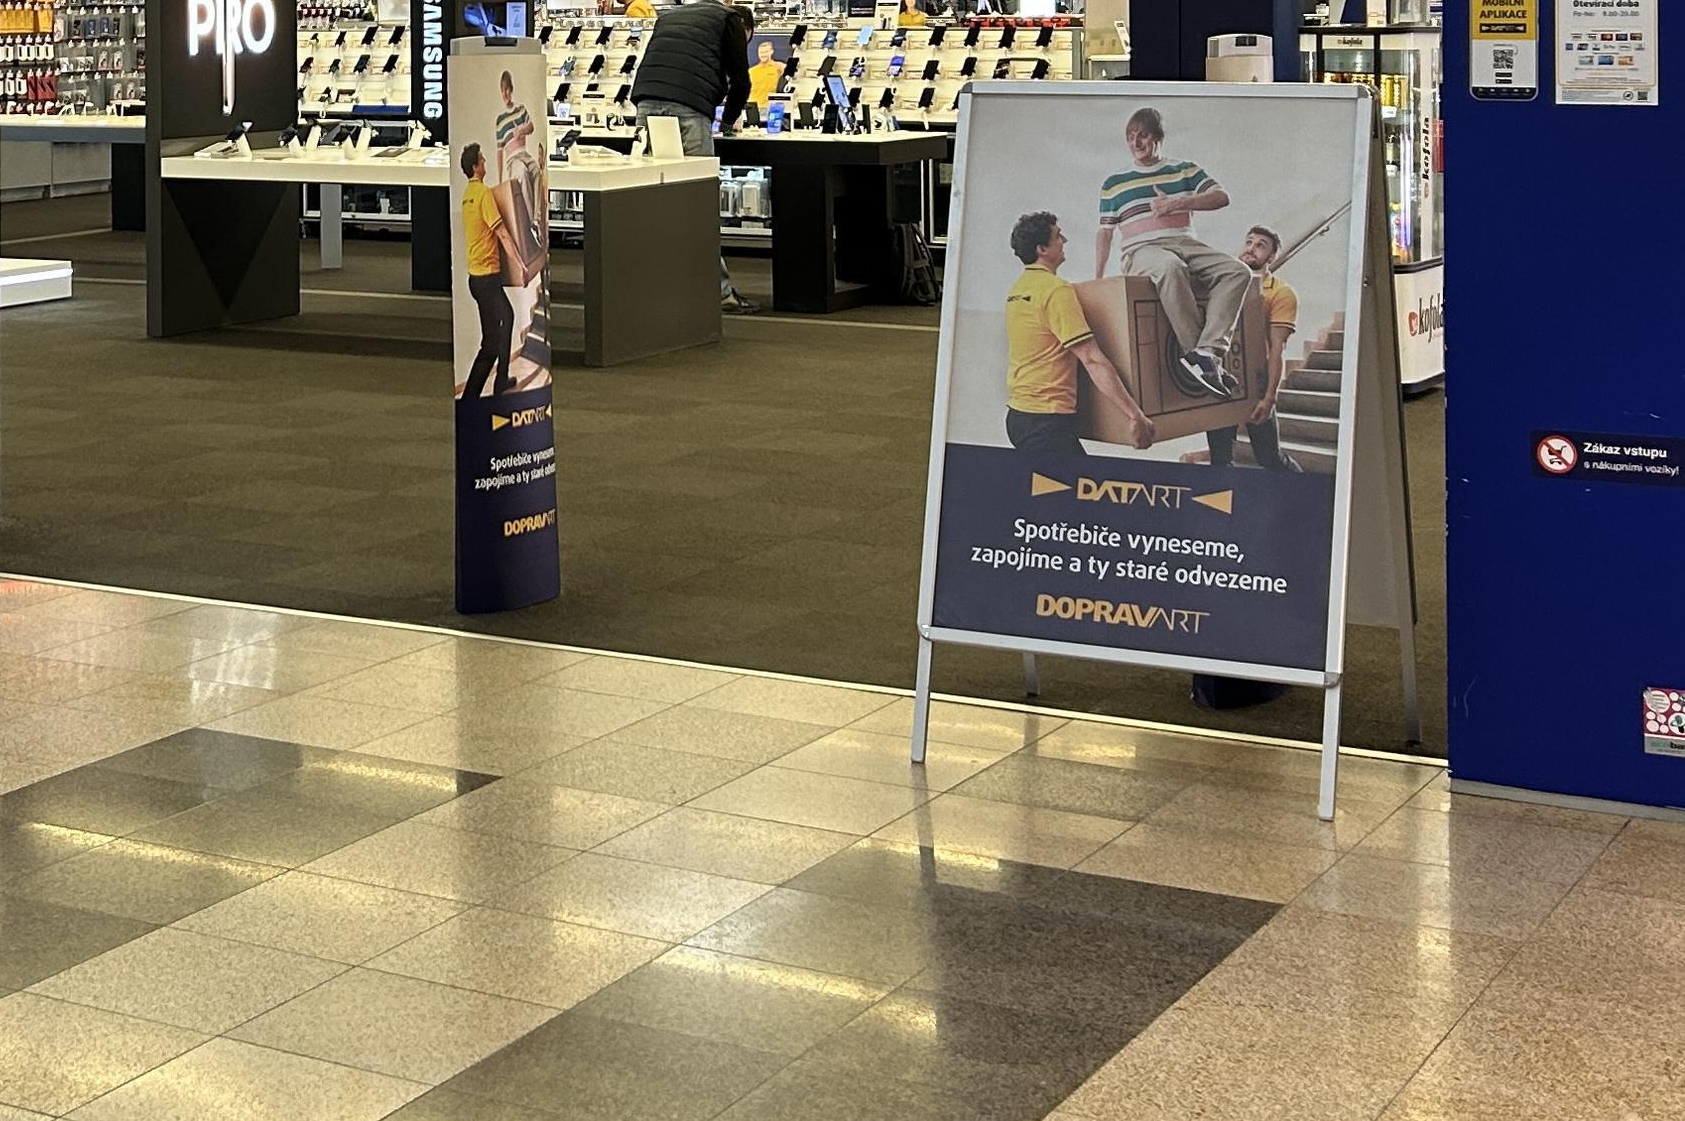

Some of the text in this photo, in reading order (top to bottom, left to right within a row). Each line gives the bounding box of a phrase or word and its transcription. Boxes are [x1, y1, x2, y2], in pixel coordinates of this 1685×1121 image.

[1479, 9, 1528, 19] APLIKACE
[1616, 0, 1640, 8] doba
[512, 405, 546, 428] DATART
[1582, 441, 1668, 460] Zákaz vstupu
[1583, 461, 1590, 469] s
[522, 469, 530, 484] ty
[1076, 477, 1192, 509] DATART
[1014, 517, 1245, 564] Spotřebiče vyneseme,
[971, 546, 1288, 594] zapojíme a ty staré odvezeme
[1035, 593, 1211, 635] DOPRAVART
